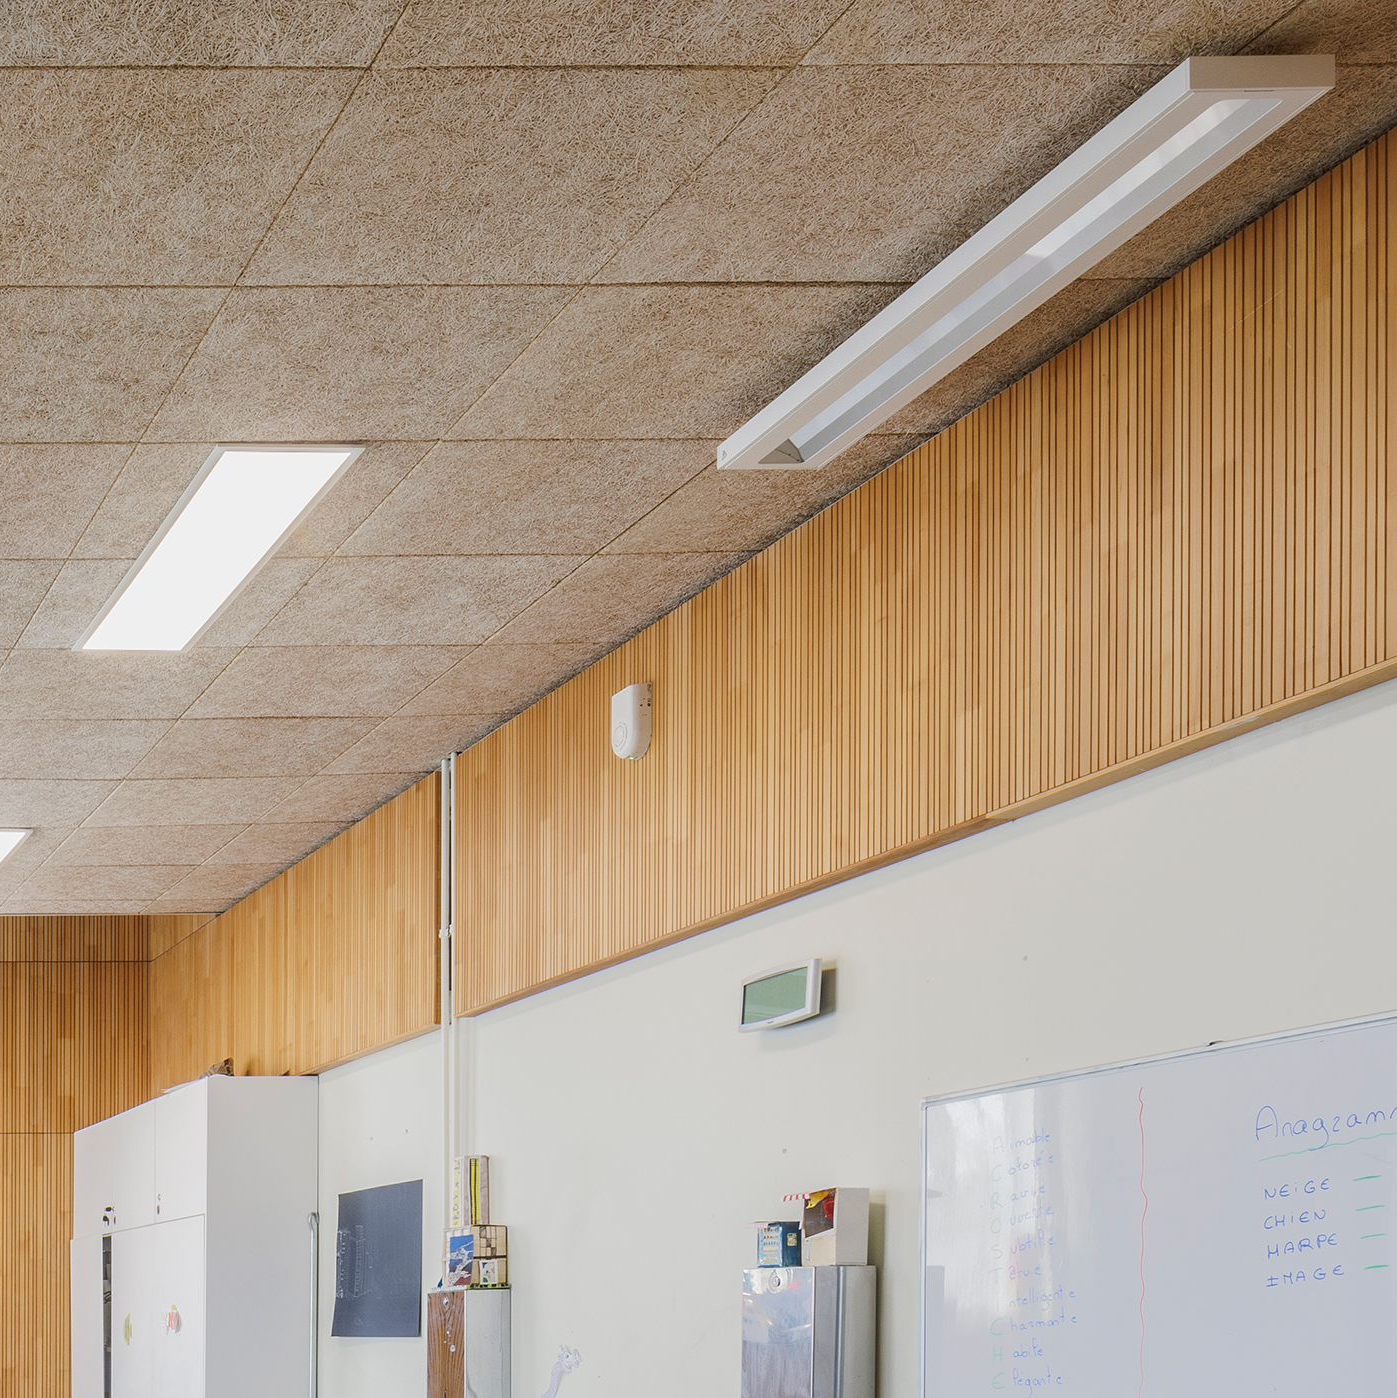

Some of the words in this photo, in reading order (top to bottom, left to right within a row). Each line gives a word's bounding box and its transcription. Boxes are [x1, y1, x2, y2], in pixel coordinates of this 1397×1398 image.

[1255, 1105, 1397, 1152] Anagram
[1267, 1232, 1338, 1259] HARPE
[1266, 1264, 1345, 1288] IMAGE
